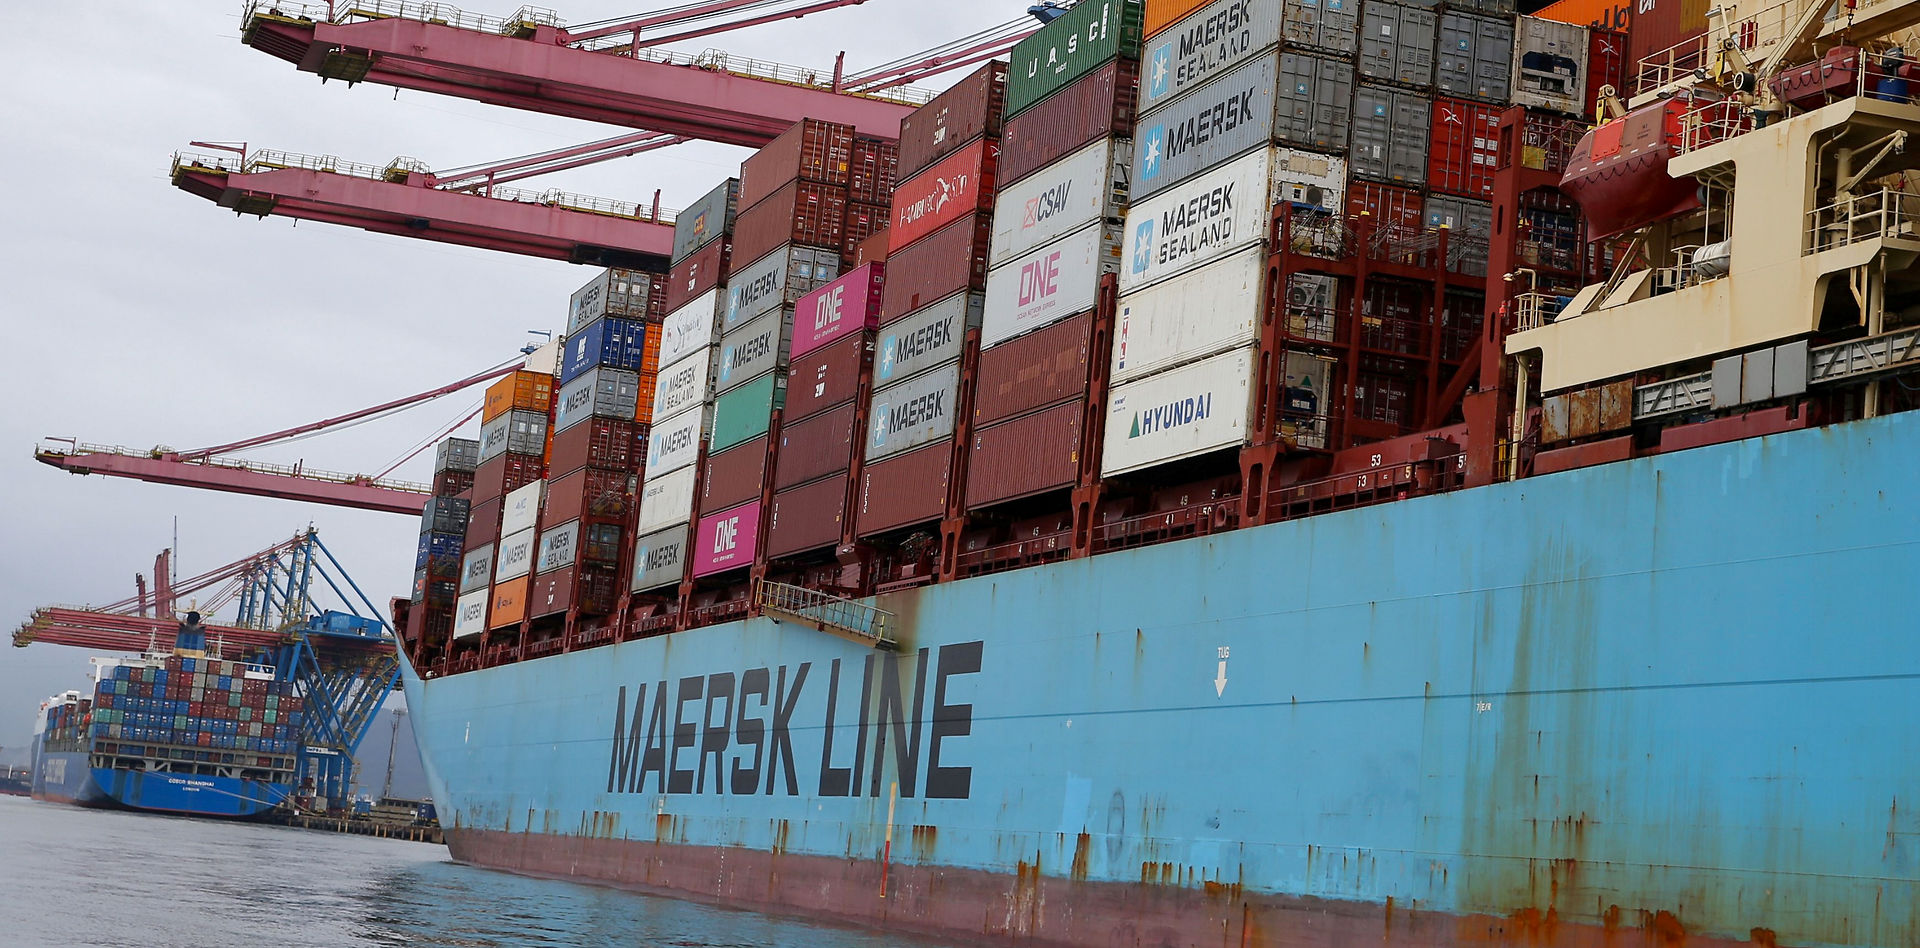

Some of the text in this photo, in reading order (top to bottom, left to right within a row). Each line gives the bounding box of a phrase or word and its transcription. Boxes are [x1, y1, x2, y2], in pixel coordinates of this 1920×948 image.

[1178, 0, 1250, 60] MAERSK
[1176, 32, 1250, 86] SEALAND
[1166, 86, 1255, 160] MAERSK
[1037, 179, 1072, 222] CSAV
[1161, 182, 1234, 238] MAERSK
[1158, 216, 1232, 265] SEALAND
[739, 267, 779, 309] MAERSK
[1018, 251, 1060, 308] ONE
[814, 285, 844, 331] ONE
[732, 331, 772, 370] MAERSK
[896, 315, 954, 364] MAERSK
[669, 364, 697, 392] MAERSK
[889, 388, 945, 434] MAERSK
[1142, 392, 1211, 435] HYUNDAI
[660, 424, 694, 458] MAERSK
[1371, 454, 1381, 467] 53
[646, 542, 680, 571] MAERSK
[714, 516, 739, 554] ONE
[1217, 646, 1230, 659] TUG
[607, 640, 984, 800] MAERSK LINE
